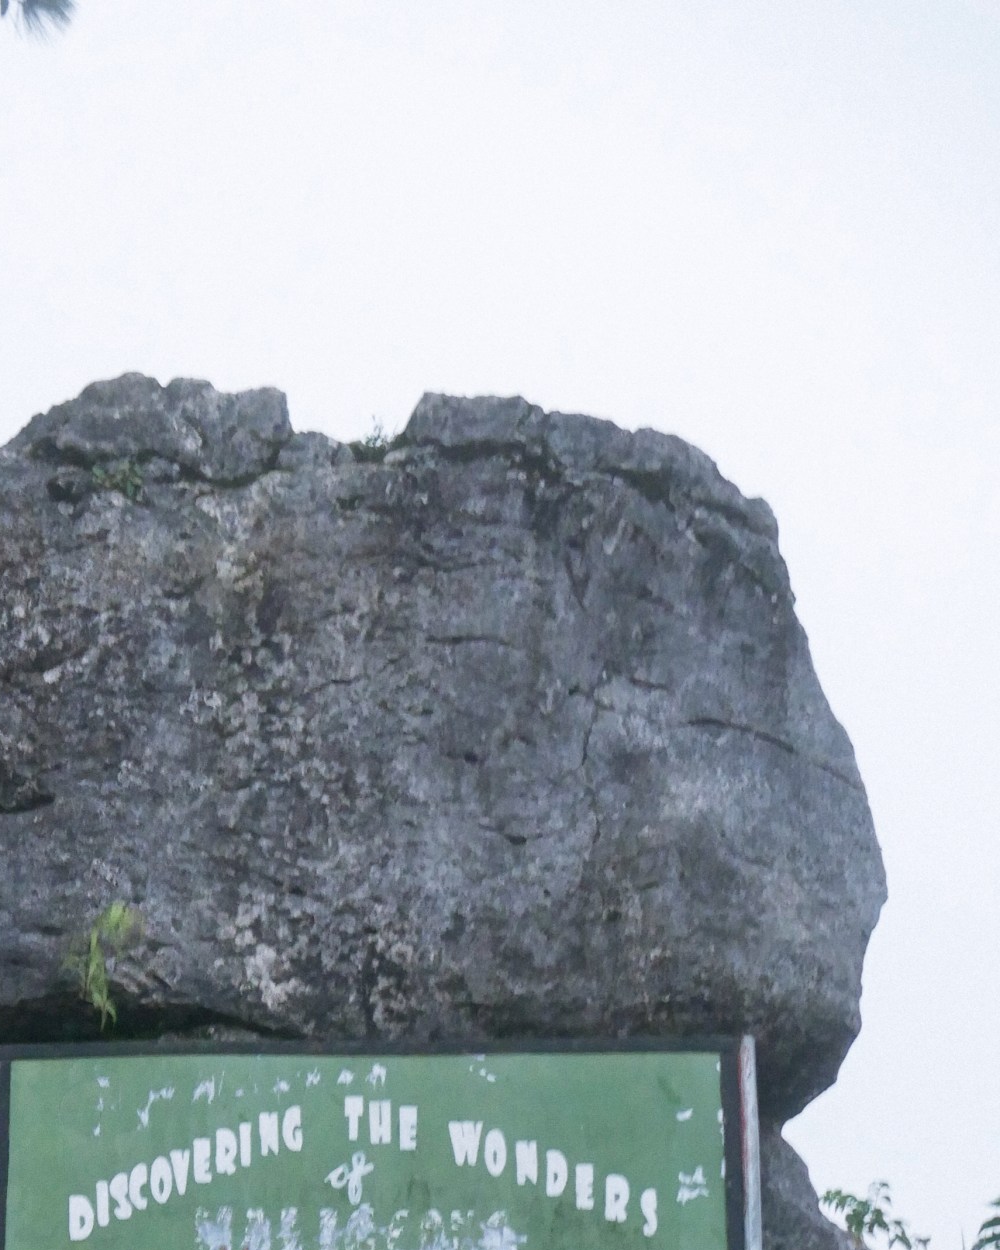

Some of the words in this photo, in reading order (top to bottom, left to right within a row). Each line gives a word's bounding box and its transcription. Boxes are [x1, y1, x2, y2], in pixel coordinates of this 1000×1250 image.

[68, 1104, 303, 1240] DISCOVERING
[344, 1095, 418, 1151] THE
[448, 1120, 658, 1238] WONDERS
[324, 1150, 374, 1206] of
